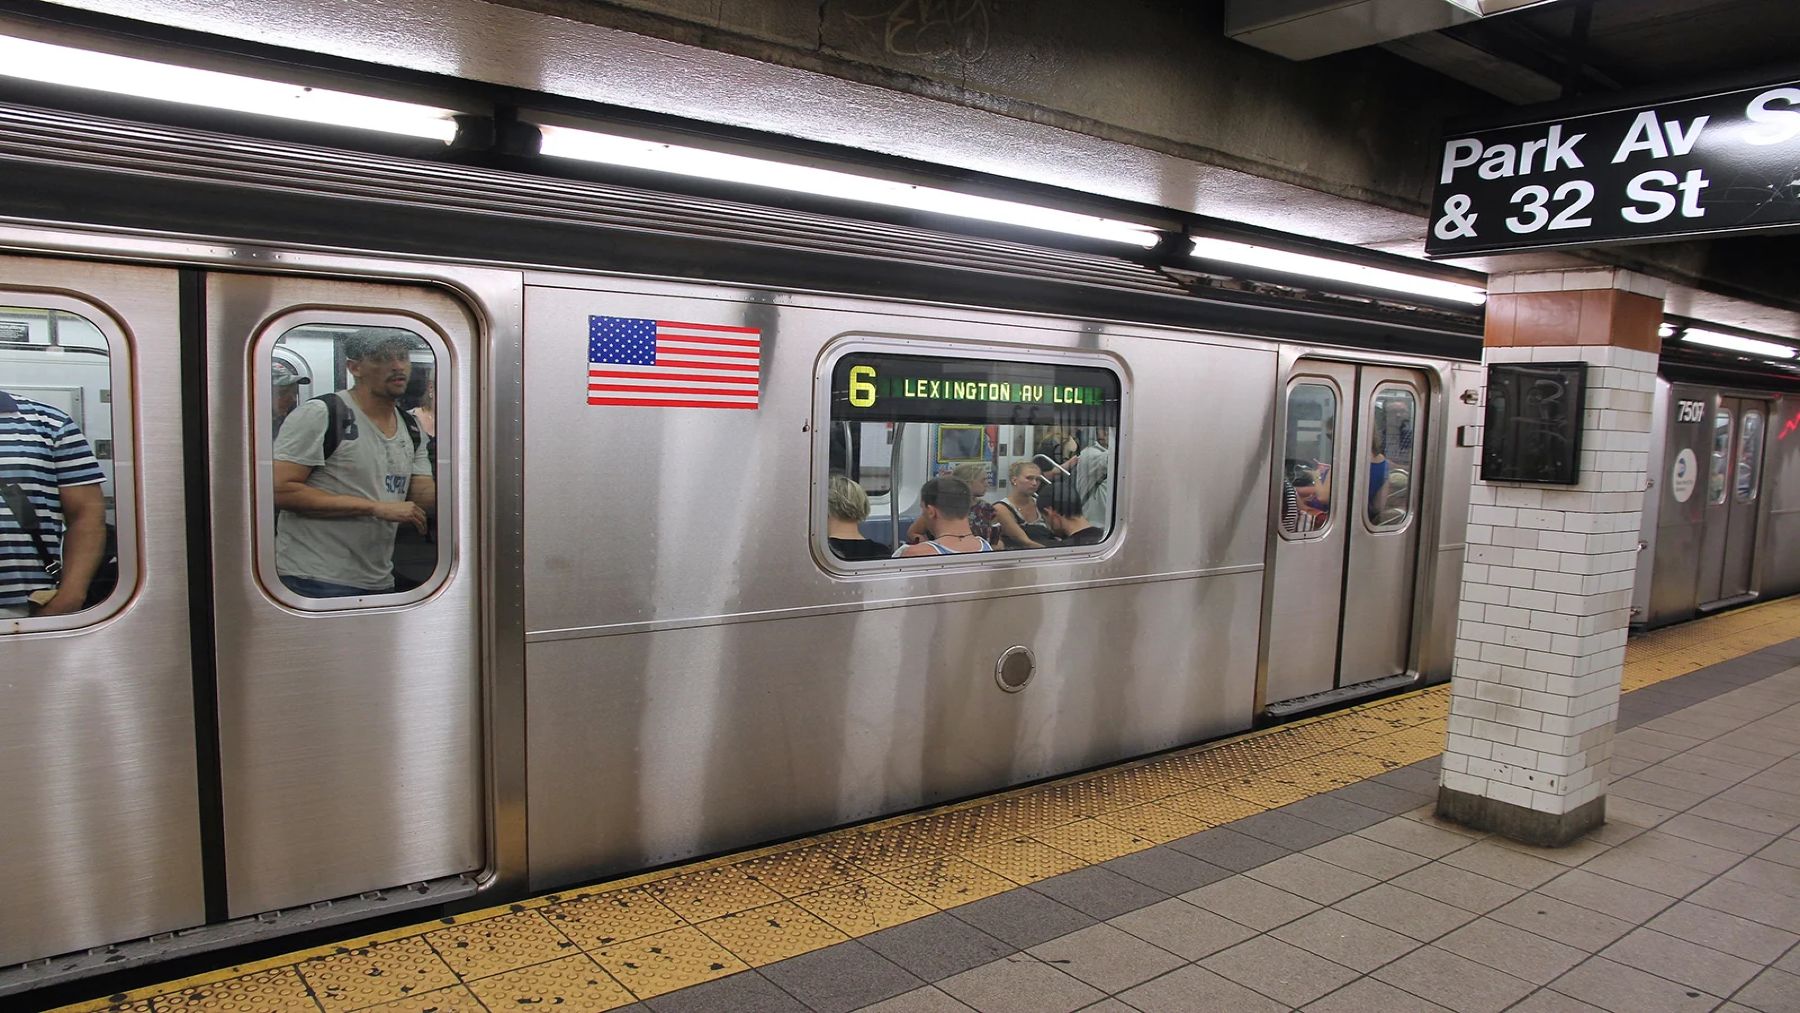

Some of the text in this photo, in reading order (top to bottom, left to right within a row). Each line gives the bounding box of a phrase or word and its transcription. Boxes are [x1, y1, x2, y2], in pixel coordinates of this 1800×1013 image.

[1440, 125, 1587, 185] Park
[1610, 110, 1711, 164] Av
[1433, 169, 1711, 241] & 32 St
[849, 365, 877, 408] 6
[904, 378, 1083, 404] LEXINGTON AV LCL
[1678, 400, 1705, 422] 7507
